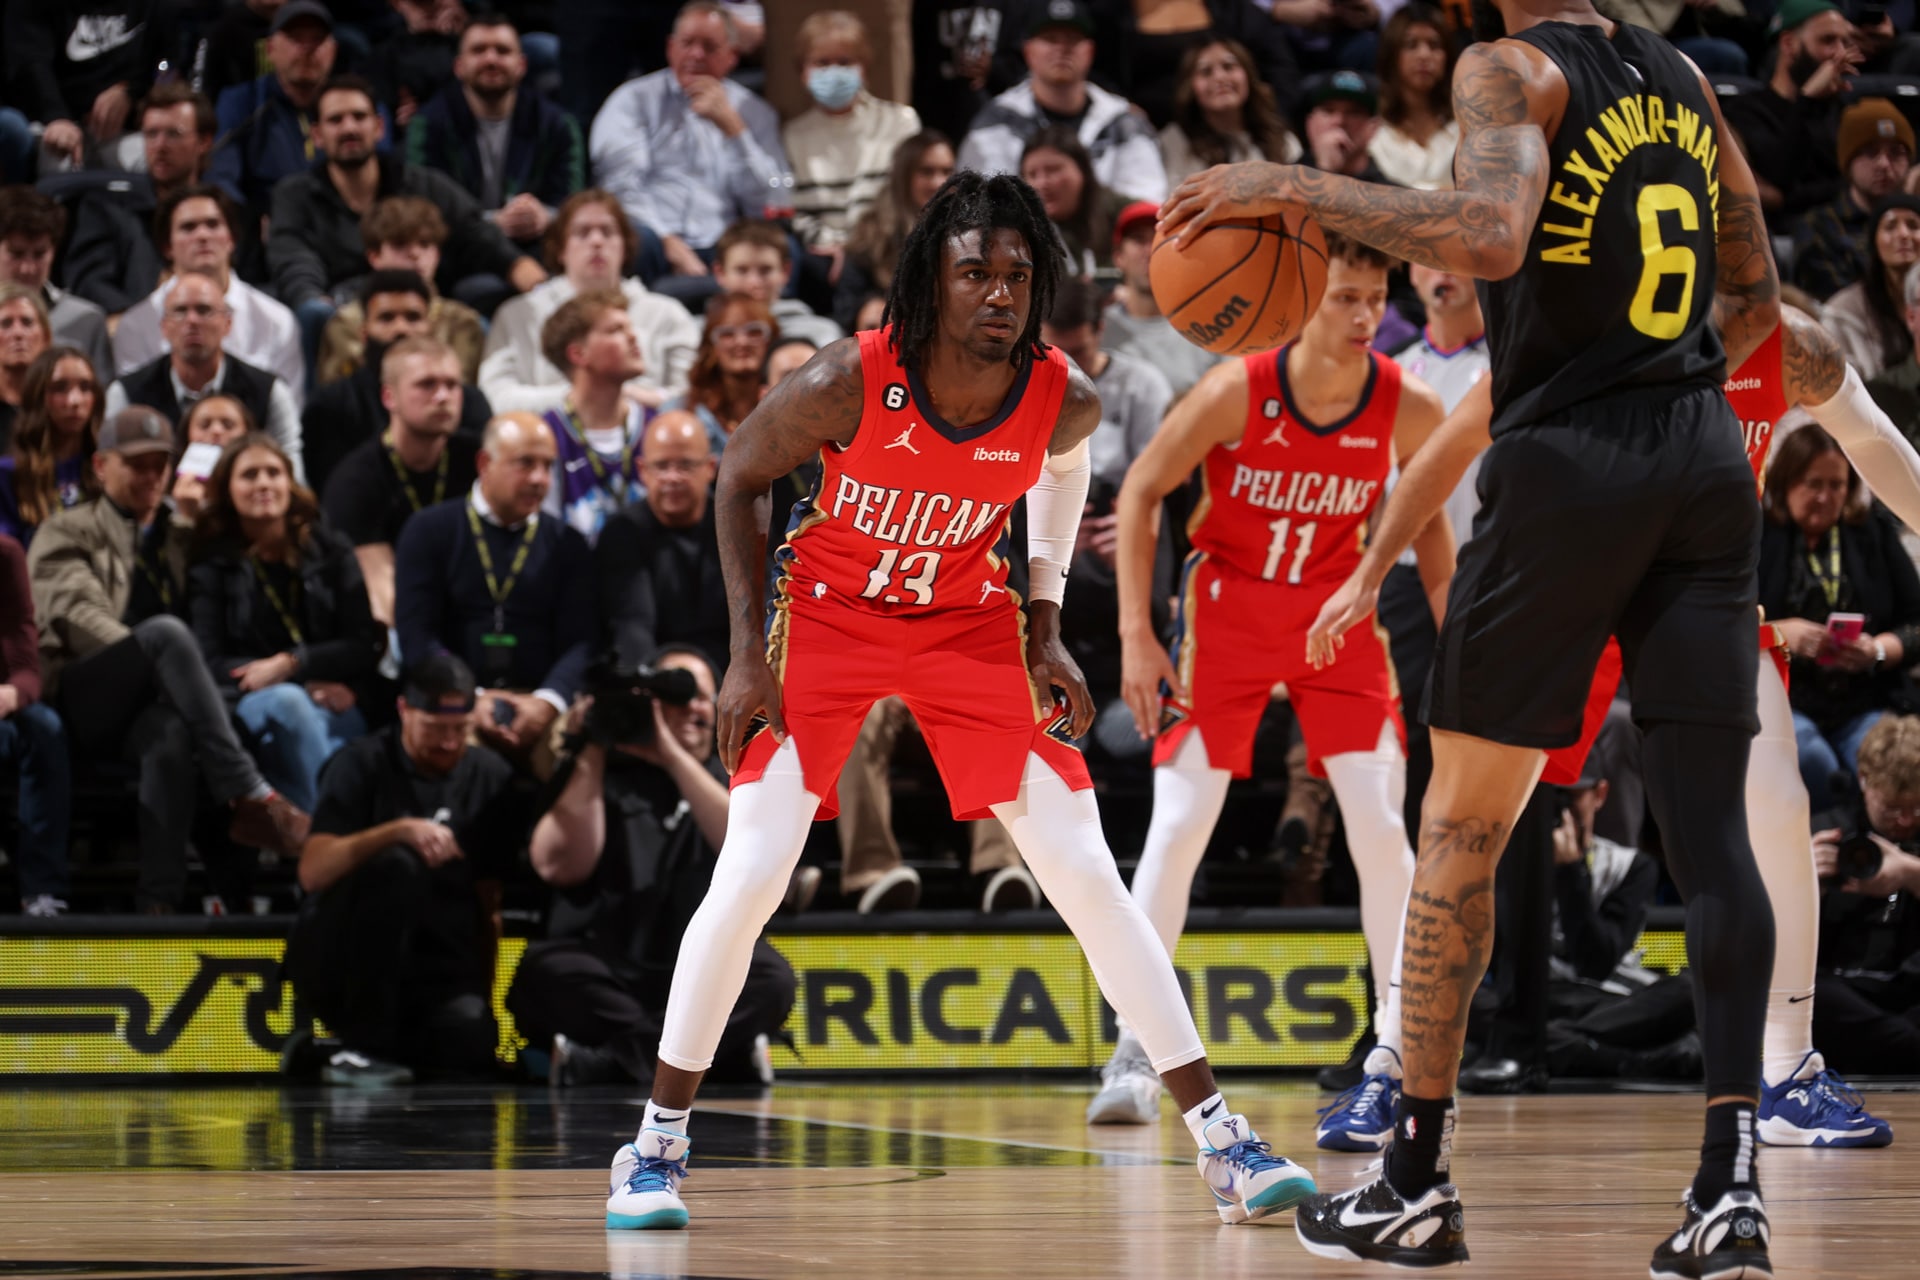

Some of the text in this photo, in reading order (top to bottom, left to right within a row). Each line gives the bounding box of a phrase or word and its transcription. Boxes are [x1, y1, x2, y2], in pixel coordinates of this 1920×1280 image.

[1540, 93, 1719, 265] ALEXANDER-WAL
[1629, 183, 1699, 340] 6
[886, 386, 904, 408] 6
[1264, 399, 1281, 418] 6
[973, 448, 1020, 462] ibotta
[832, 473, 1010, 547] PELICAN
[1230, 463, 1378, 516] PELICANS
[858, 549, 943, 606] 13
[1261, 517, 1318, 585] 11
[768, 967, 1073, 1045] RICA
